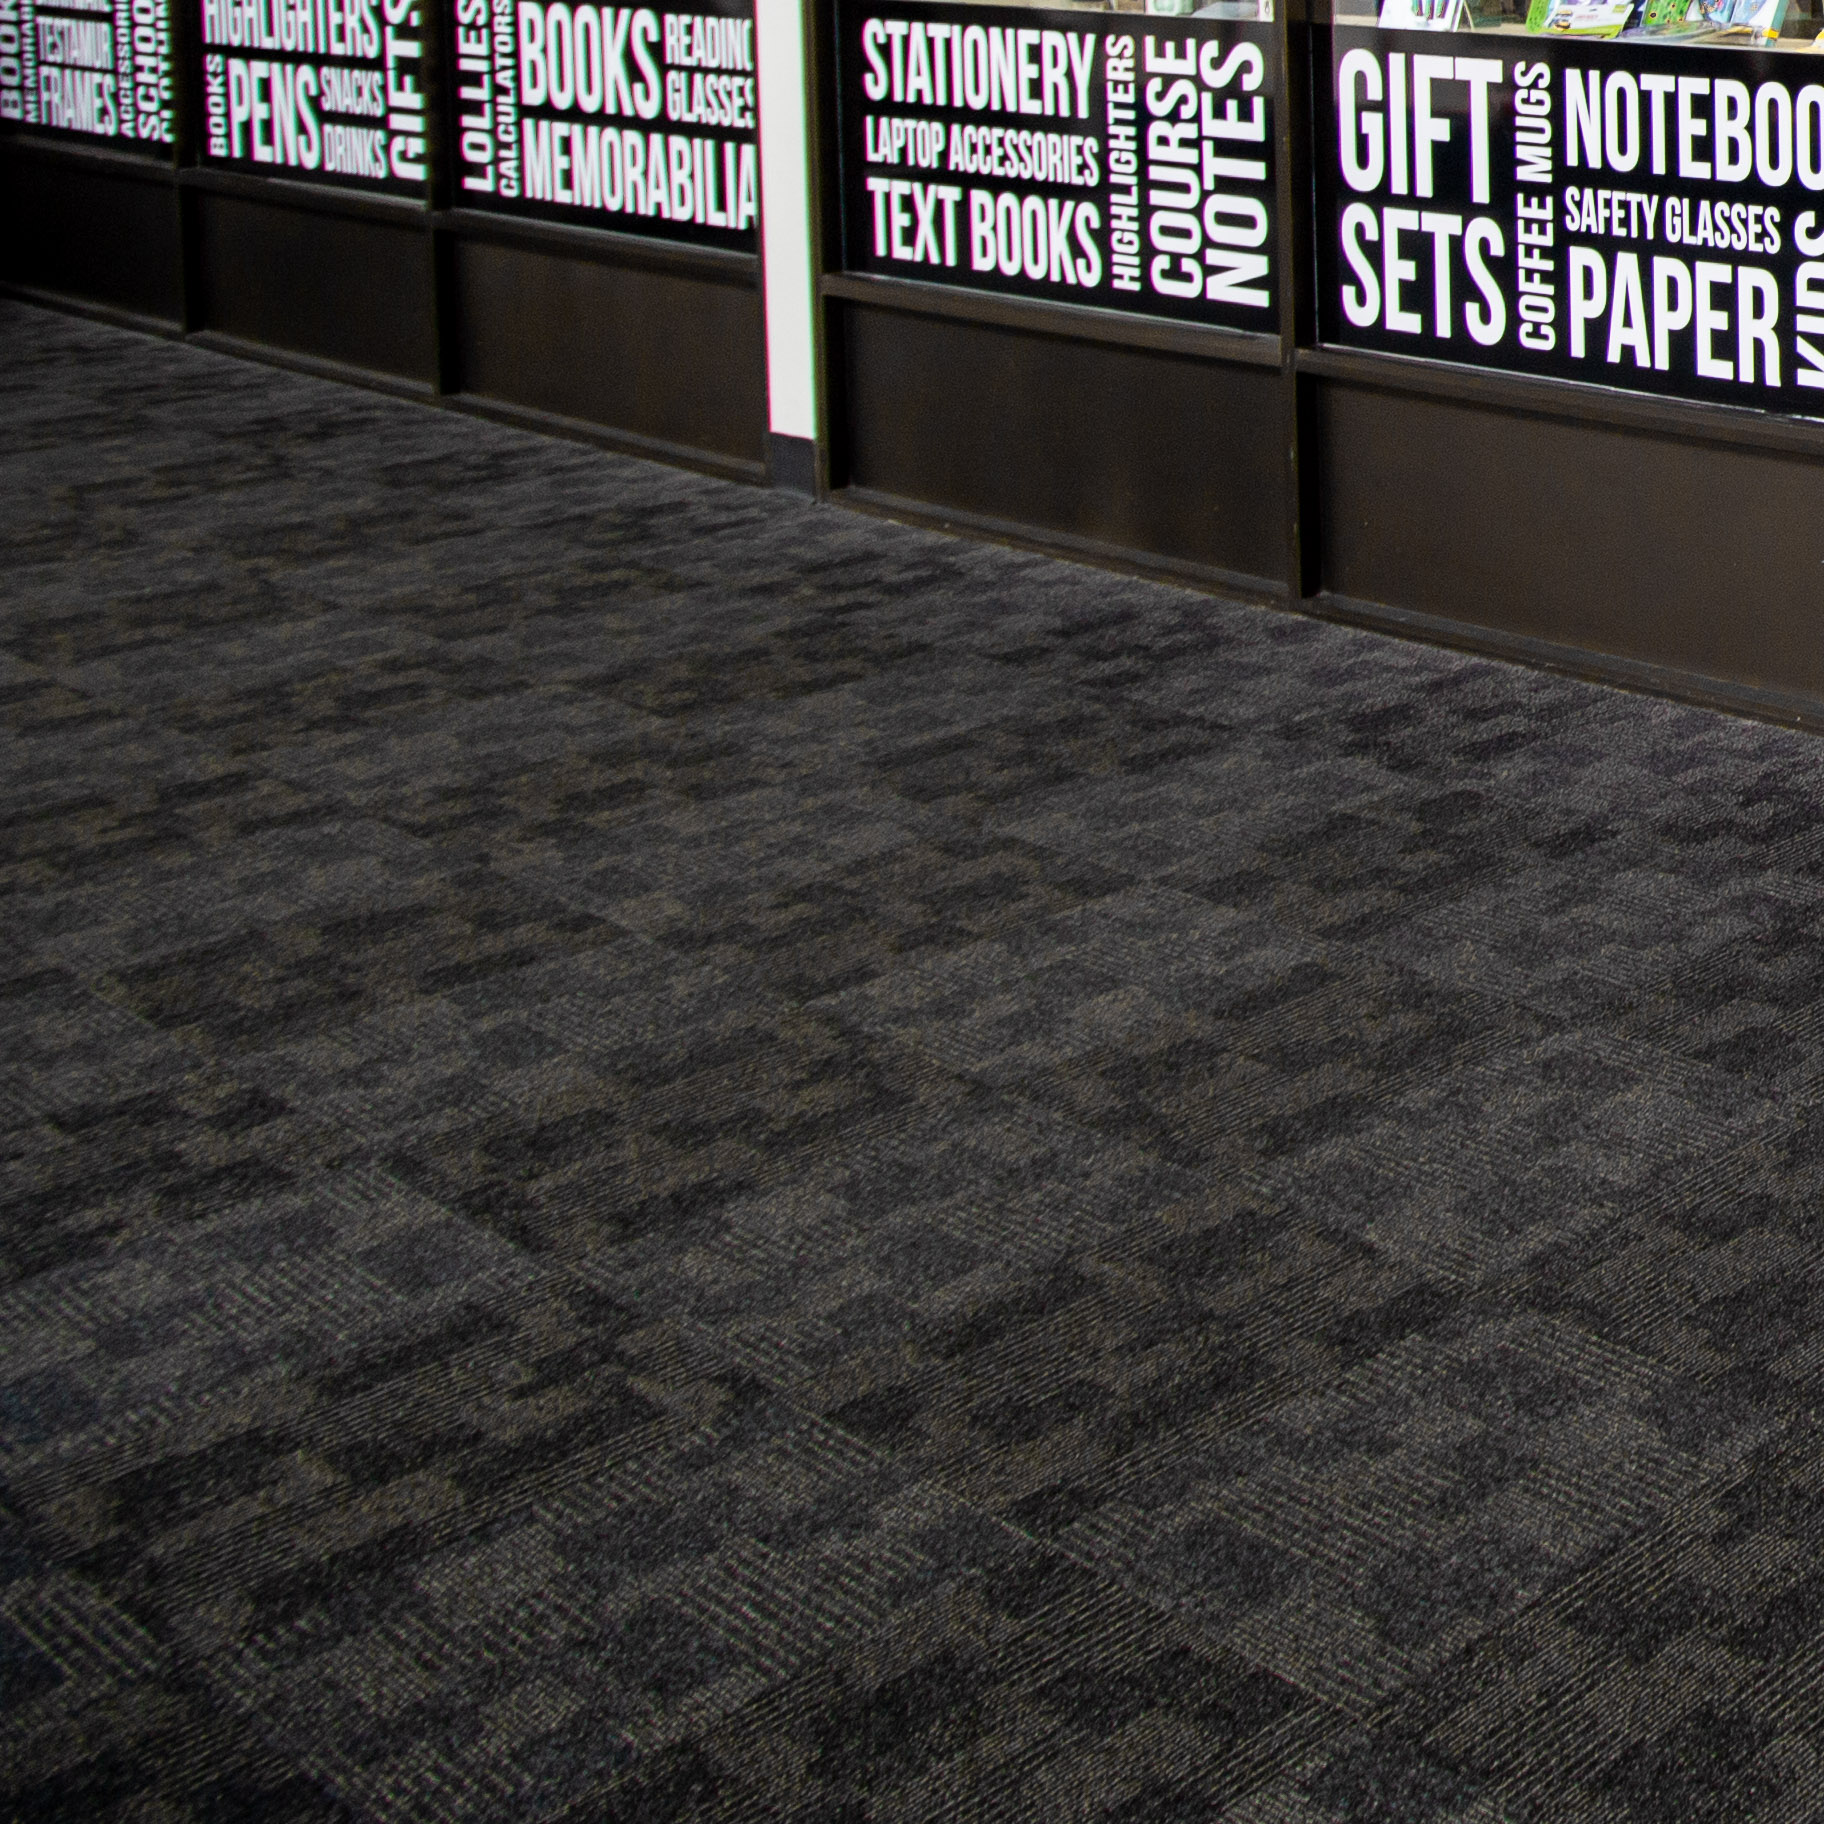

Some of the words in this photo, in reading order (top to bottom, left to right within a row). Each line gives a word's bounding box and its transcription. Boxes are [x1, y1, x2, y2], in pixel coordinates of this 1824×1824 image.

[38, 65, 120, 137] FRAMES
[206, 53, 230, 158] BOOKS
[228, 57, 322, 170] PENS
[319, 66, 386, 118] SNACKS
[517, 1, 661, 120] BOOKS
[861, 17, 1097, 120] STATIONERY
[322, 123, 389, 180] DRINKS
[521, 117, 758, 231] MEMORABILIA
[864, 114, 946, 169] LAPTOP
[948, 123, 1100, 188] ACCESSORIES
[1105, 33, 1142, 293] HIGHLIGHTERS
[1144, 33, 1203, 300] COURSE
[1199, 38, 1271, 309] NOTES
[1338, 48, 1504, 205] GIFT
[1513, 61, 1553, 184] MUGS
[866, 176, 962, 268] TEXT
[970, 188, 1102, 289] BOOKS
[1340, 202, 1507, 347] SETS
[1517, 195, 1557, 352] COFFEE
[1564, 184, 1659, 240] SAFETY
[1664, 196, 1783, 256] GLASSES
[1568, 245, 1783, 388] PAPER
